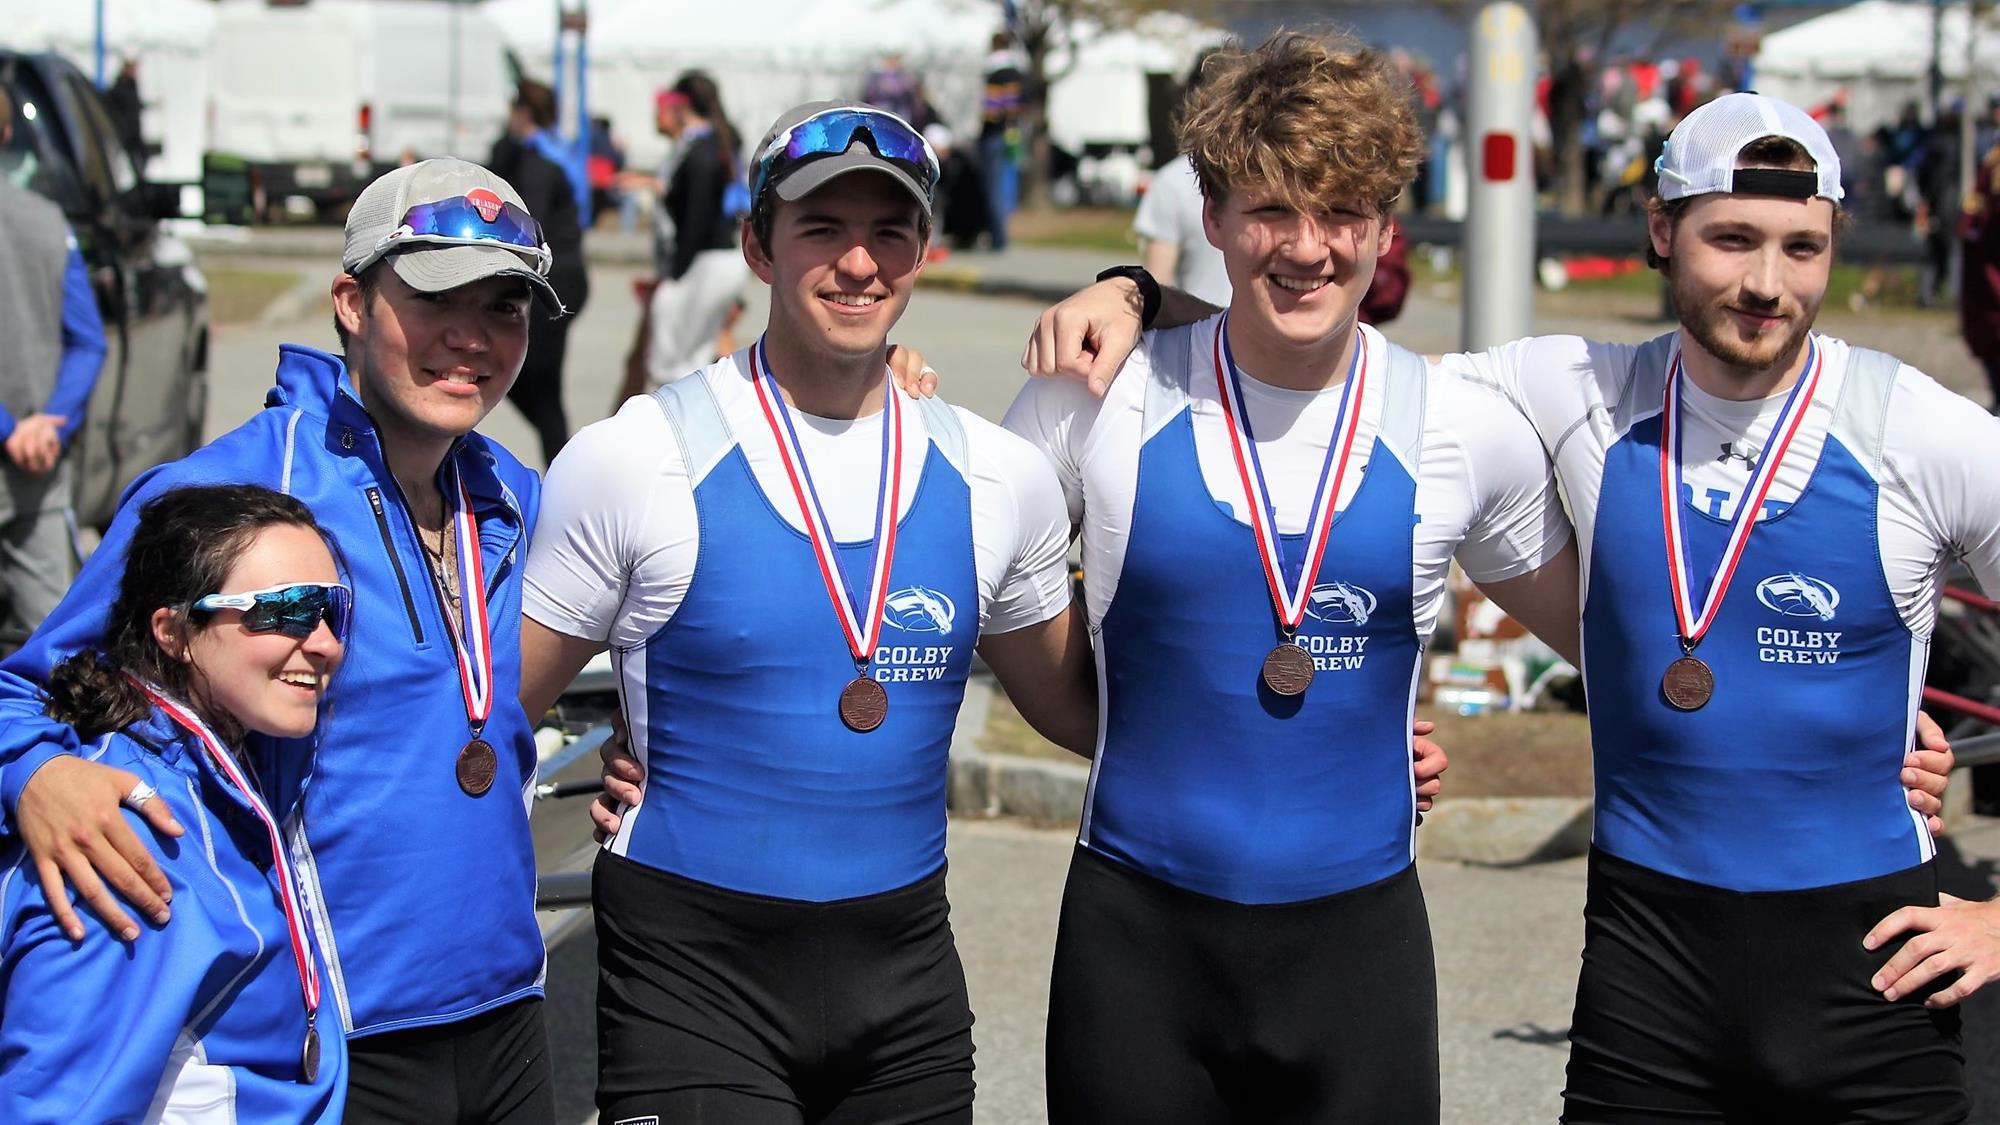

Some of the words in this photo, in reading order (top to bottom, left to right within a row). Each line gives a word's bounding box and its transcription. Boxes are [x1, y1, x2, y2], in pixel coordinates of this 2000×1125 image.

[1295, 635, 1369, 654] COLBY
[1757, 627, 1842, 648] COLBY
[874, 646, 953, 665] COLBY
[1313, 656, 1364, 671] REW
[1759, 647, 1840, 664] CREW
[875, 667, 947, 682] CREW
